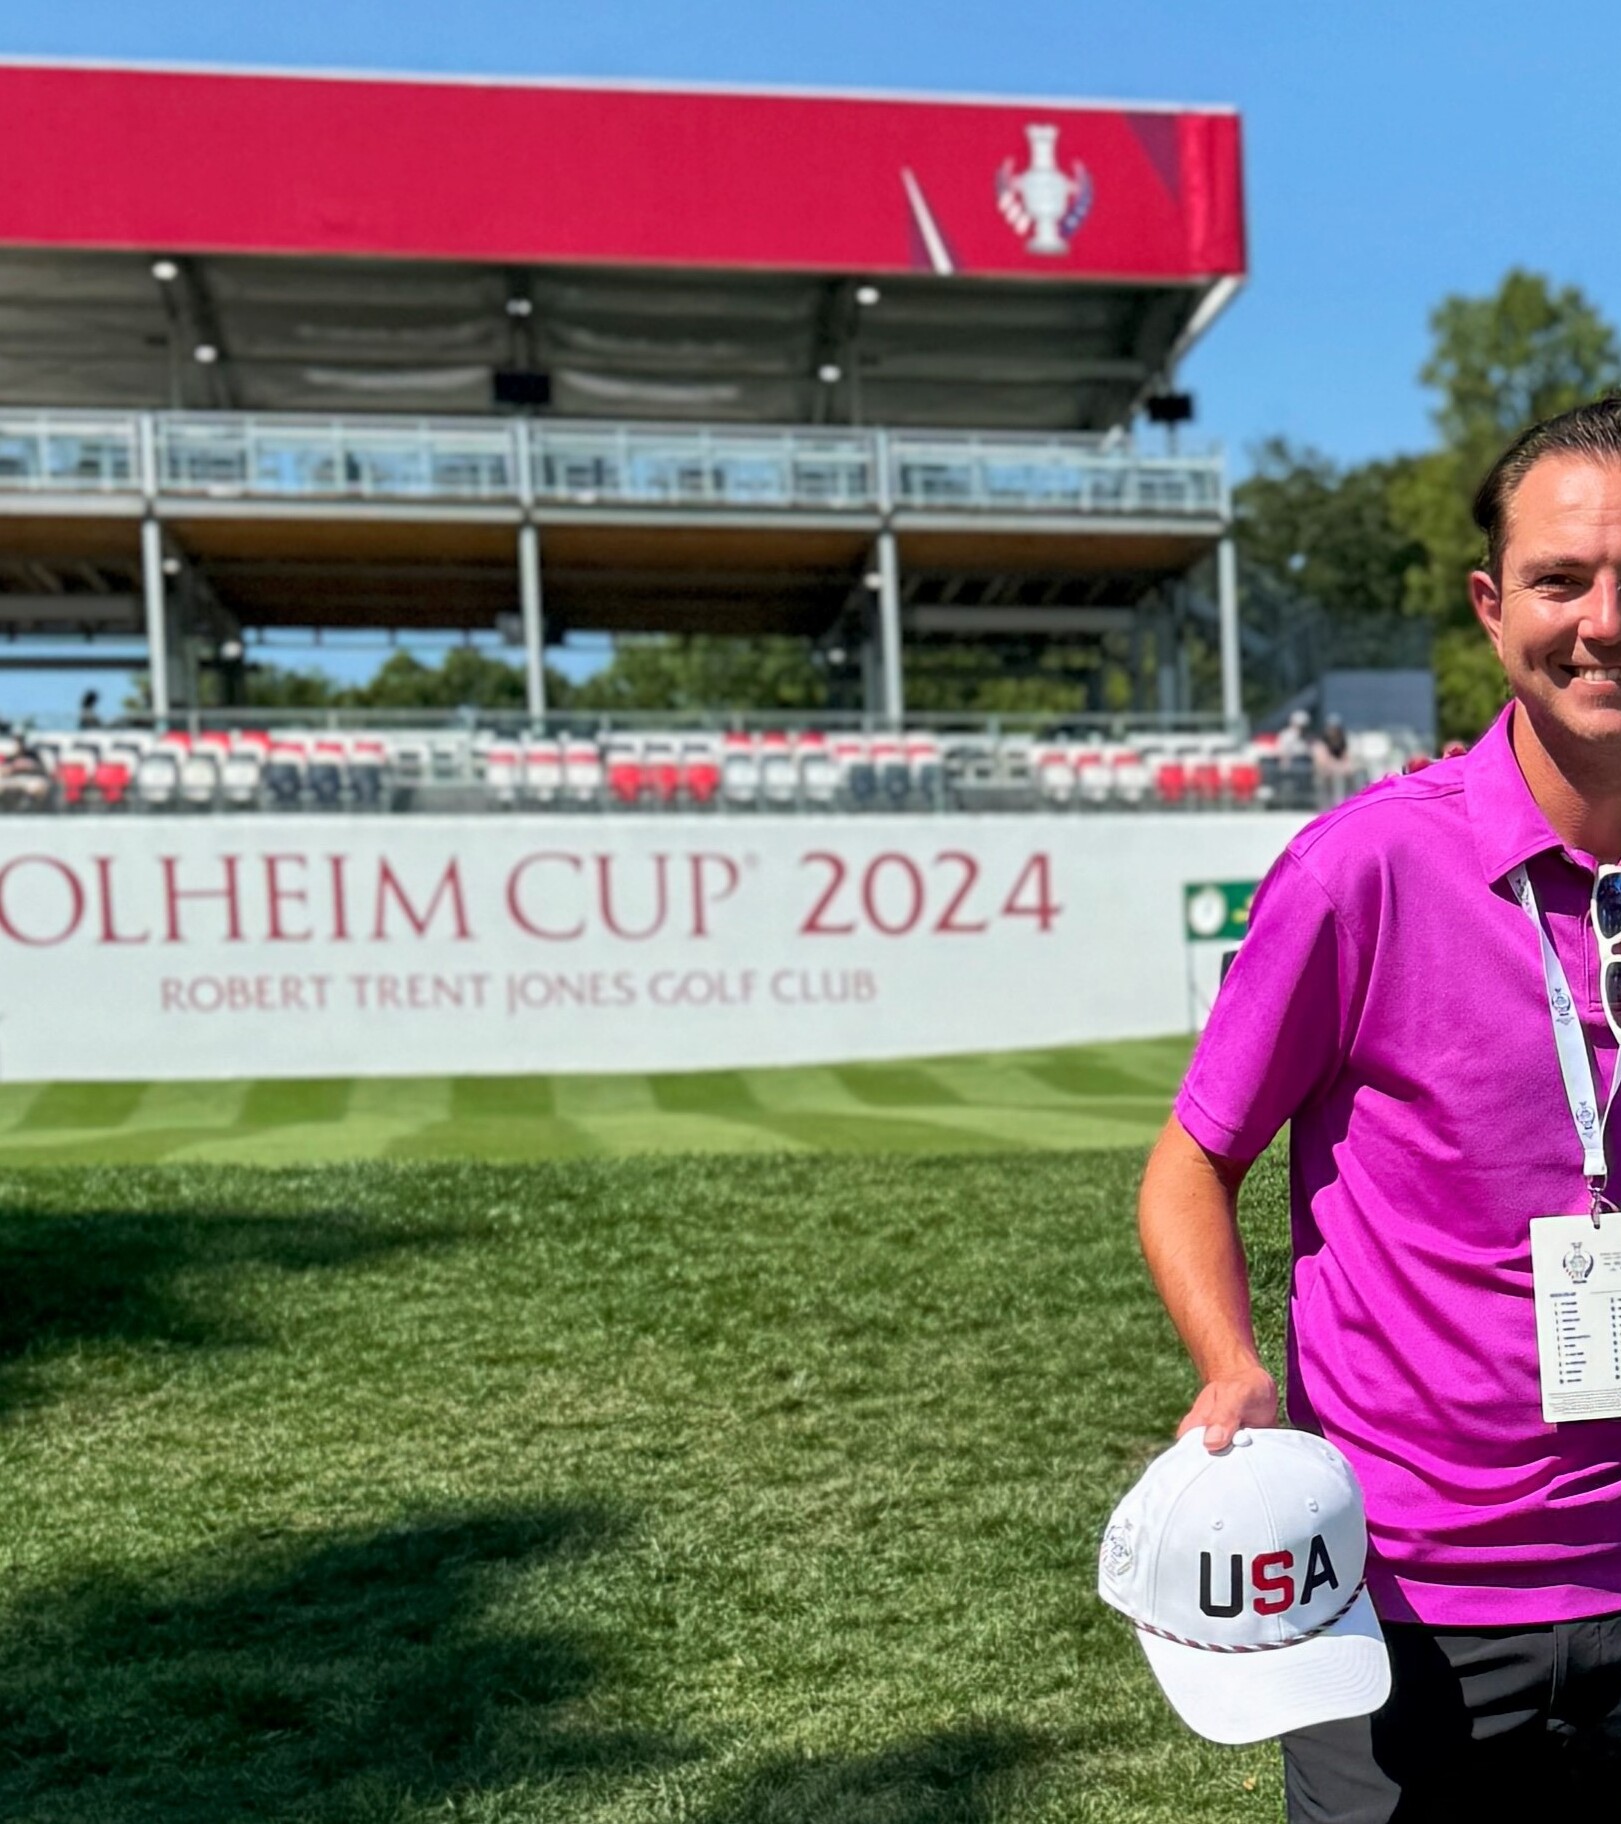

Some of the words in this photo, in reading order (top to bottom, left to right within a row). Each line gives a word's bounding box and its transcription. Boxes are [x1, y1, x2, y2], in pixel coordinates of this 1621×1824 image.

[799, 850, 1063, 937] 2024
[160, 974, 331, 1013] ROBERT
[350, 972, 490, 1009] TRENT
[506, 970, 637, 1016] JONES
[648, 969, 758, 1007] GOLF
[770, 968, 878, 1004] CLUB
[1199, 1533, 1340, 1618] USA
